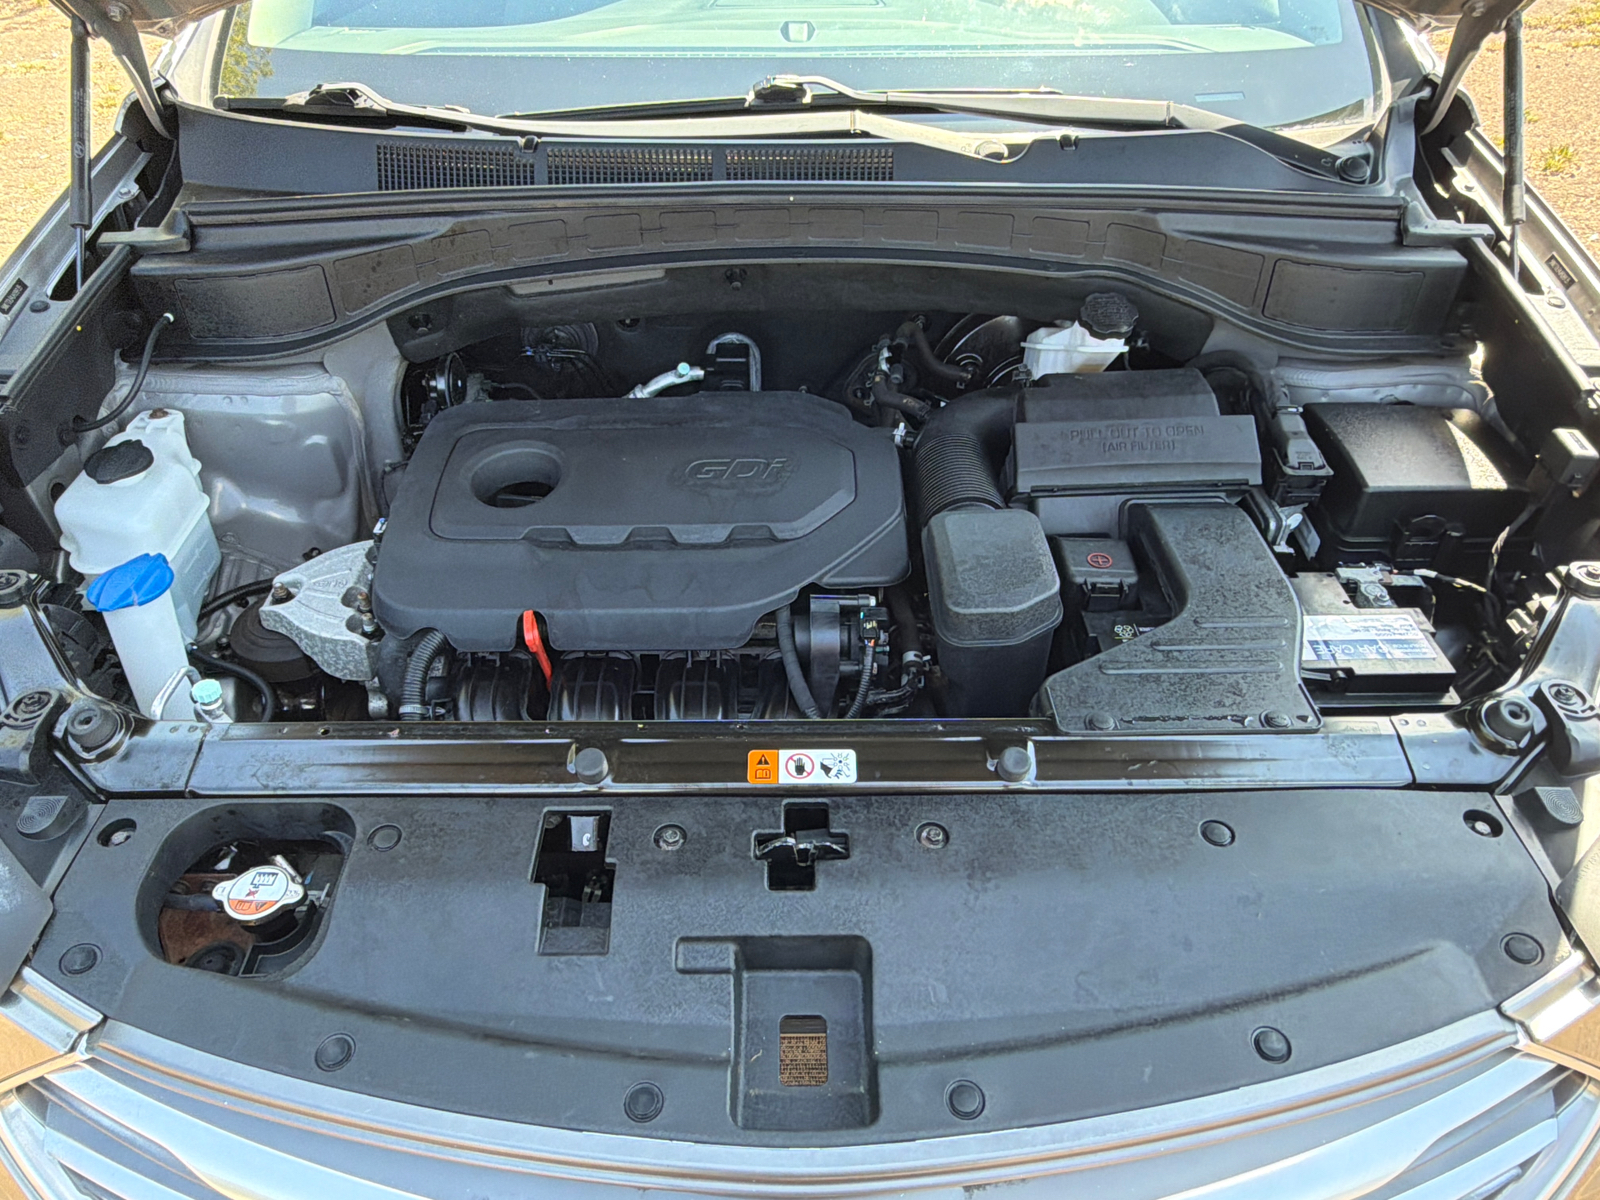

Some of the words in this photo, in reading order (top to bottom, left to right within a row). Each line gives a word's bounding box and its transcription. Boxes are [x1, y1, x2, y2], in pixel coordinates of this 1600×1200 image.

[1070, 428, 1106, 441] PULL
[1110, 426, 1139, 440] OUT
[1144, 426, 1162, 438] TO
[1165, 424, 1205, 437] OPEN
[1312, 644, 1355, 655] CARE
